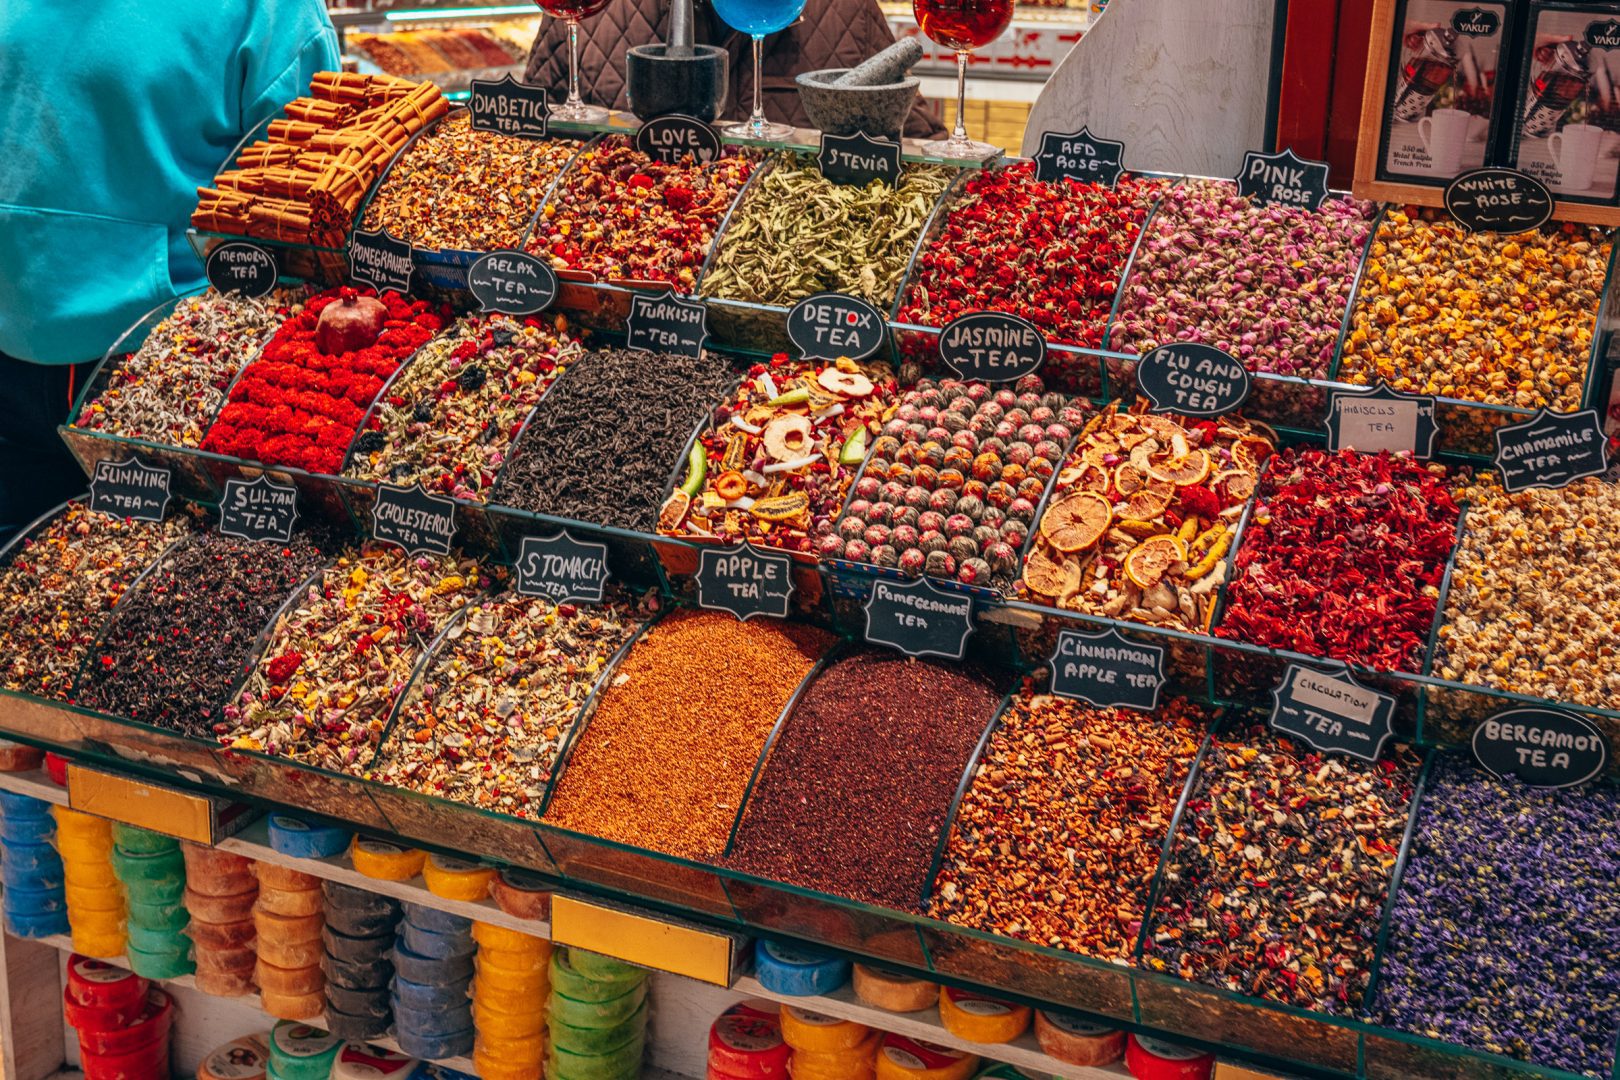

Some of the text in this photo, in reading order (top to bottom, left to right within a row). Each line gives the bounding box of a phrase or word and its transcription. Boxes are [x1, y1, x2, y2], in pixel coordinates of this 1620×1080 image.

[1459, 22, 1491, 33] YAKUT
[475, 93, 543, 121] DIABETIC
[496, 117, 521, 131] TEA
[649, 127, 700, 146] LOVE
[658, 147, 698, 164] TEA
[1061, 141, 1096, 156] RED
[1056, 155, 1102, 171] ROSE
[1249, 159, 1304, 187] PINK
[1271, 184, 1313, 203] ROSE
[1474, 192, 1522, 208] ROSE
[230, 264, 258, 279] TEA
[369, 267, 387, 283] TEA
[487, 257, 537, 278] RELAX
[491, 277, 527, 295] TEA
[638, 301, 701, 324] TURKISH
[803, 303, 872, 330] DETOX
[648, 328, 678, 346] TEA
[814, 326, 861, 349] TEA
[968, 349, 1018, 368] TEA
[1154, 349, 1242, 379] FLU AND
[1167, 371, 1232, 397] COUGH
[1175, 390, 1218, 410] TEA
[1368, 423, 1396, 432] TEA
[1523, 454, 1561, 471] TEA
[98, 464, 166, 491] SLIMMING
[114, 494, 141, 510] TEA
[235, 486, 294, 507] SULTAN
[241, 512, 278, 530] TEA
[376, 502, 452, 537] CHOLESTEROL
[397, 528, 418, 544] TEA
[522, 552, 602, 581] STOMACH
[715, 555, 778, 580] APPLE
[545, 581, 570, 597] TEA
[727, 582, 759, 600] TEA
[894, 612, 928, 629] TEA
[1064, 662, 1157, 688] APPLE TEA
[1300, 678, 1368, 709] CIRCULATION
[1303, 710, 1343, 736] TEA
[1485, 720, 1601, 752] BERGAMOT
[1516, 747, 1570, 769] TEA
